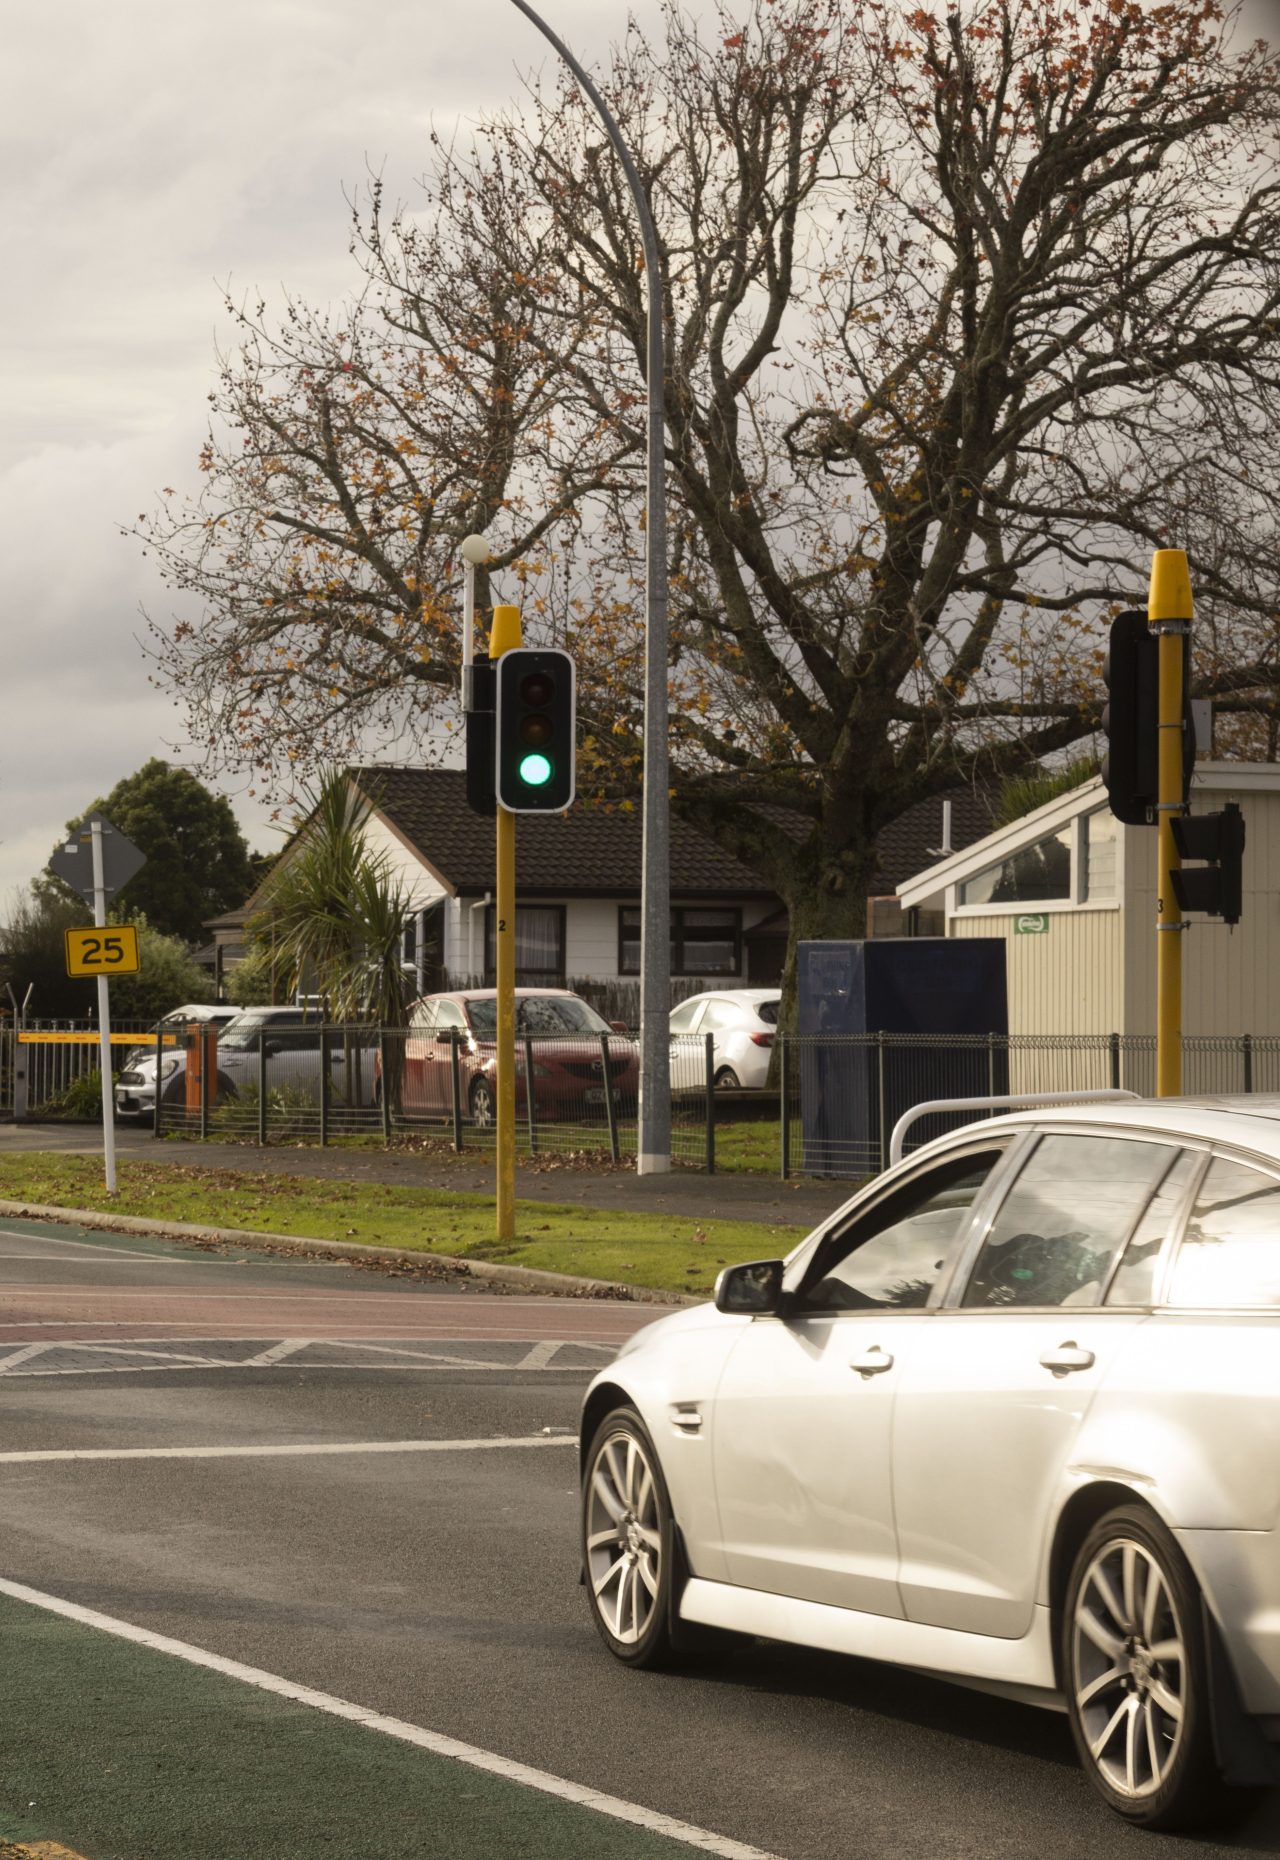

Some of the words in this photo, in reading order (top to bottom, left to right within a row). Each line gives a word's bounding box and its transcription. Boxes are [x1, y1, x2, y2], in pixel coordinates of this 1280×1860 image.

[1158, 898, 1164, 913] 3
[499, 919, 506, 931] 2
[81, 937, 124, 965] 25
